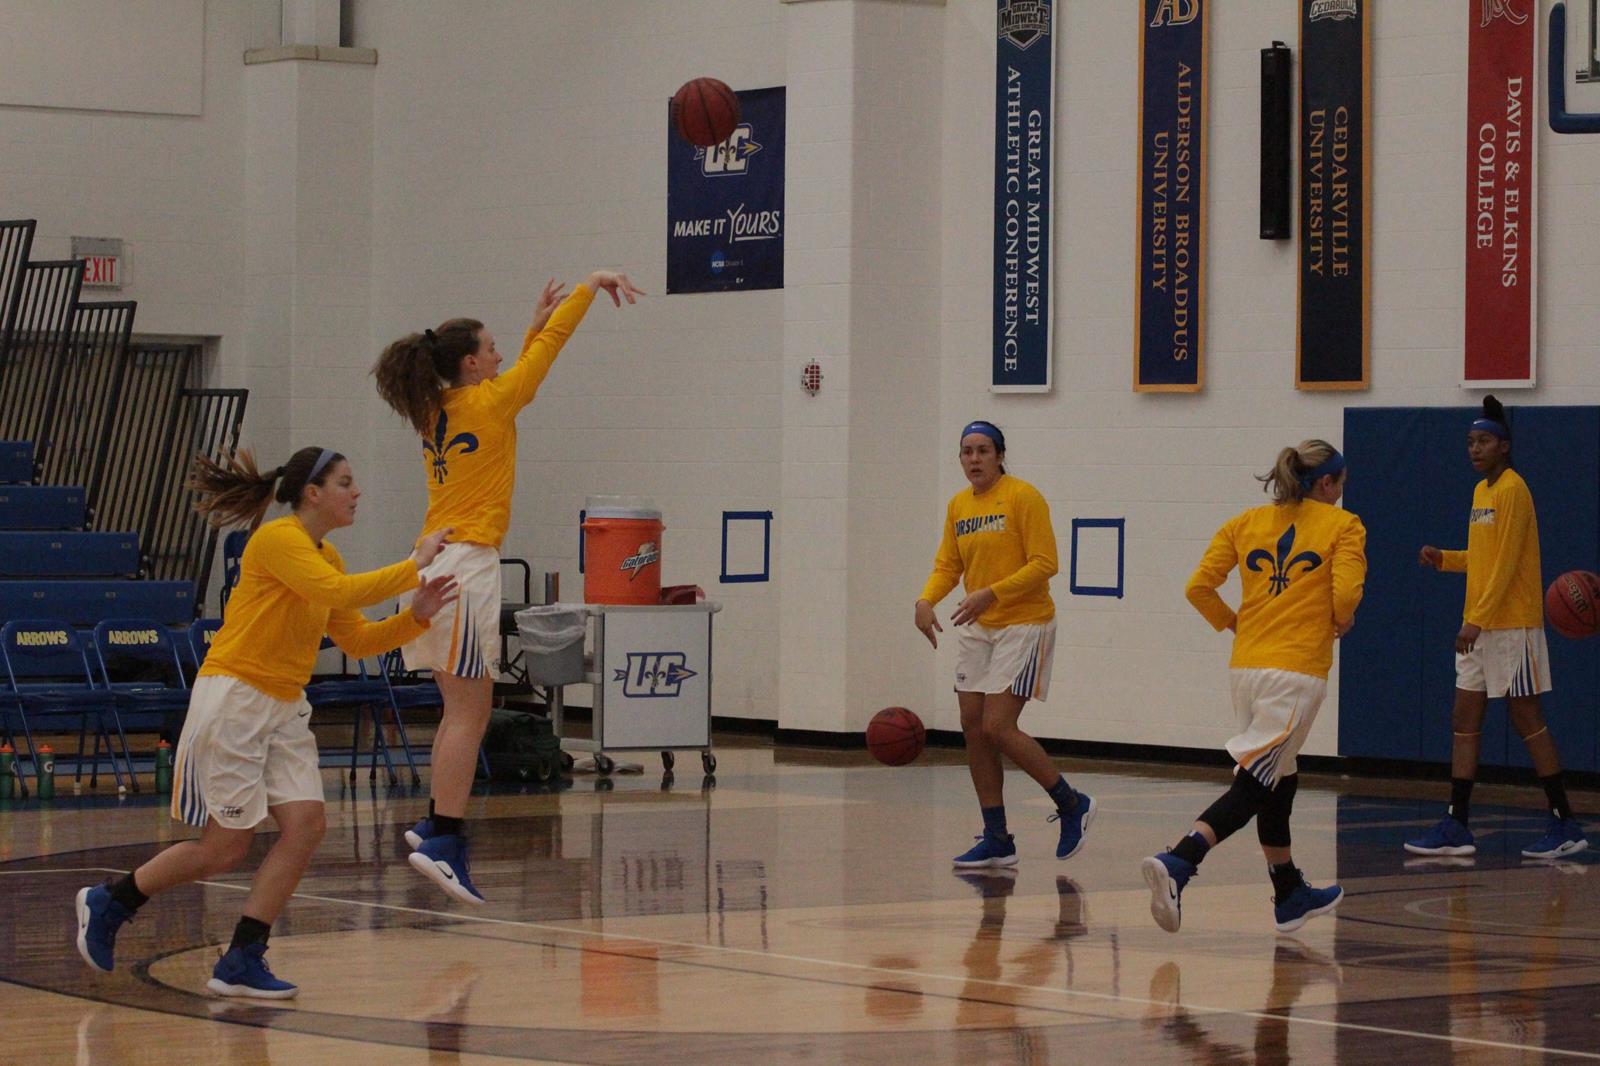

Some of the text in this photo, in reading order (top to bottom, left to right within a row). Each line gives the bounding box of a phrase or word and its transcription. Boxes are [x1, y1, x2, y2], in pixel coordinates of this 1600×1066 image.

[1001, 8, 1047, 28] MIDWEST
[1012, 2, 1037, 16] GREAT
[673, 203, 780, 244] MAKE IT YOURS
[1004, 66, 1021, 372] ATHLETIC CONFERENCE
[1025, 109, 1042, 325] GREAT MIDWEST
[1152, 131, 1169, 291] UNIVERSITY
[1173, 62, 1192, 361] ALDERSON BROADDUS
[1309, 109, 1326, 276] UNIVERSITY
[1332, 105, 1349, 277] CEDARVILLE
[1476, 122, 1497, 249] COLLEGE
[1502, 76, 1522, 288] DAVIS & ELKINS
[83, 256, 116, 282] EXIT
[955, 514, 1005, 537] URSULINE
[16, 630, 68, 646] ARROWS
[108, 629, 159, 645] ARROWS
